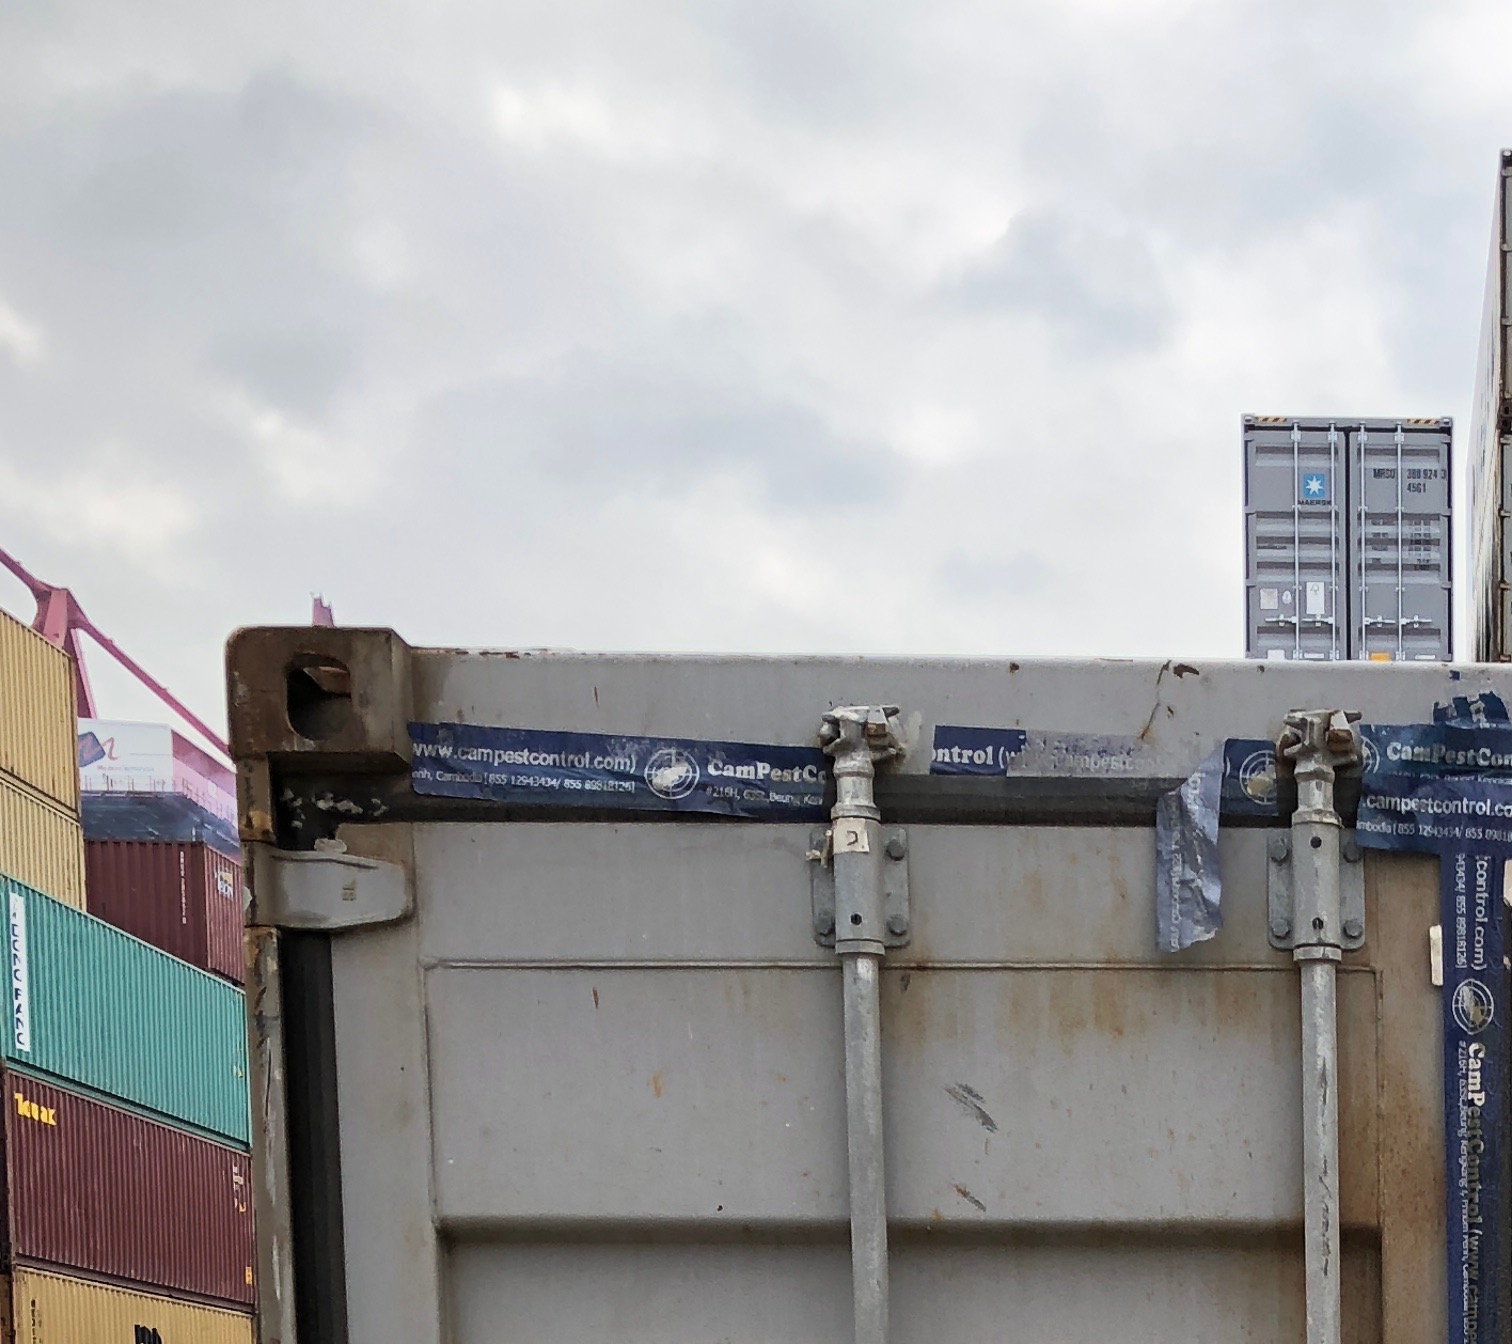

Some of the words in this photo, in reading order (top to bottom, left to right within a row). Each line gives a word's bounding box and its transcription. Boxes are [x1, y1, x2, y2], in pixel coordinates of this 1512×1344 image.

[1423, 469, 1437, 479] 924
[1407, 483, 1426, 493] 45G1
[1467, 1042, 1486, 1225] CamPestControl
